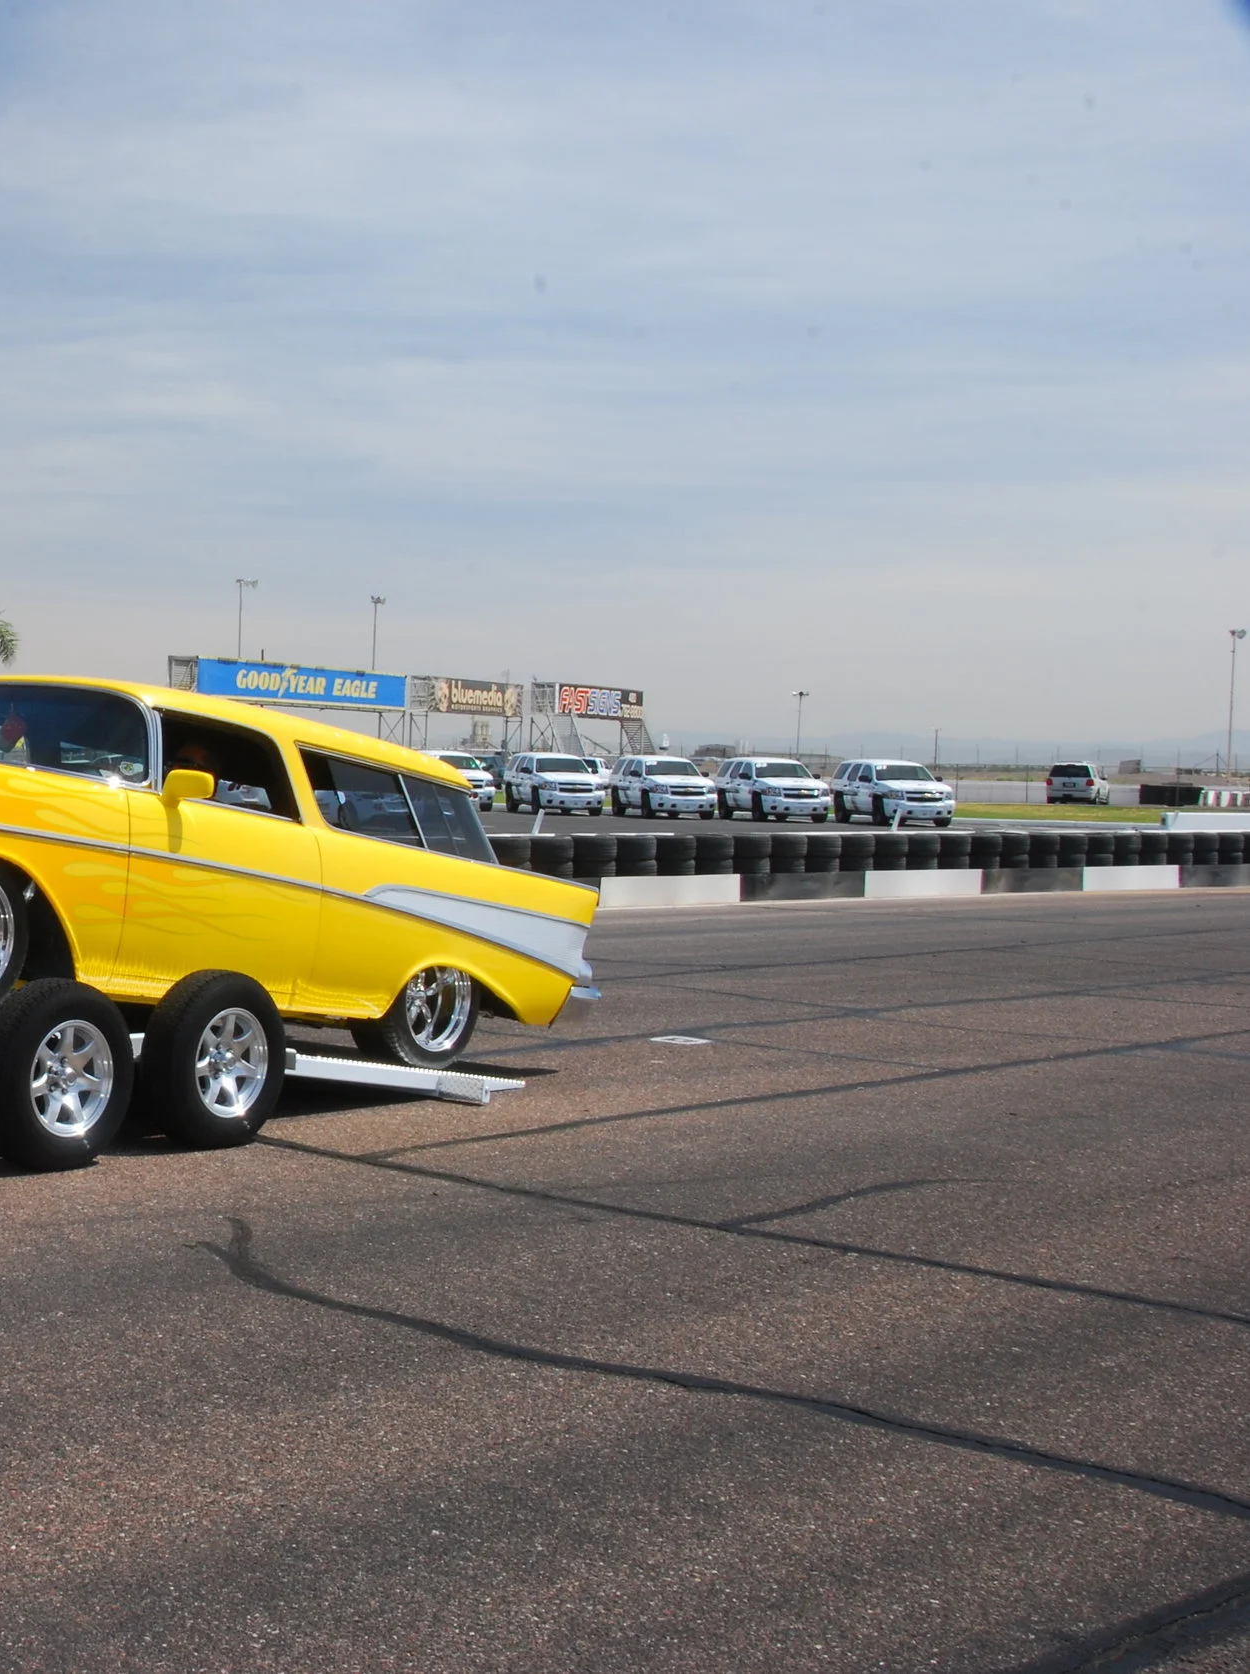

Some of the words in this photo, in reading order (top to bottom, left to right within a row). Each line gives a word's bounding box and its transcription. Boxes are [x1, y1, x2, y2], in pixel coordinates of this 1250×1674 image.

[236, 669, 326, 696] GOODYEAR
[332, 678, 378, 698] EAGLE
[451, 680, 503, 707] bluemedia
